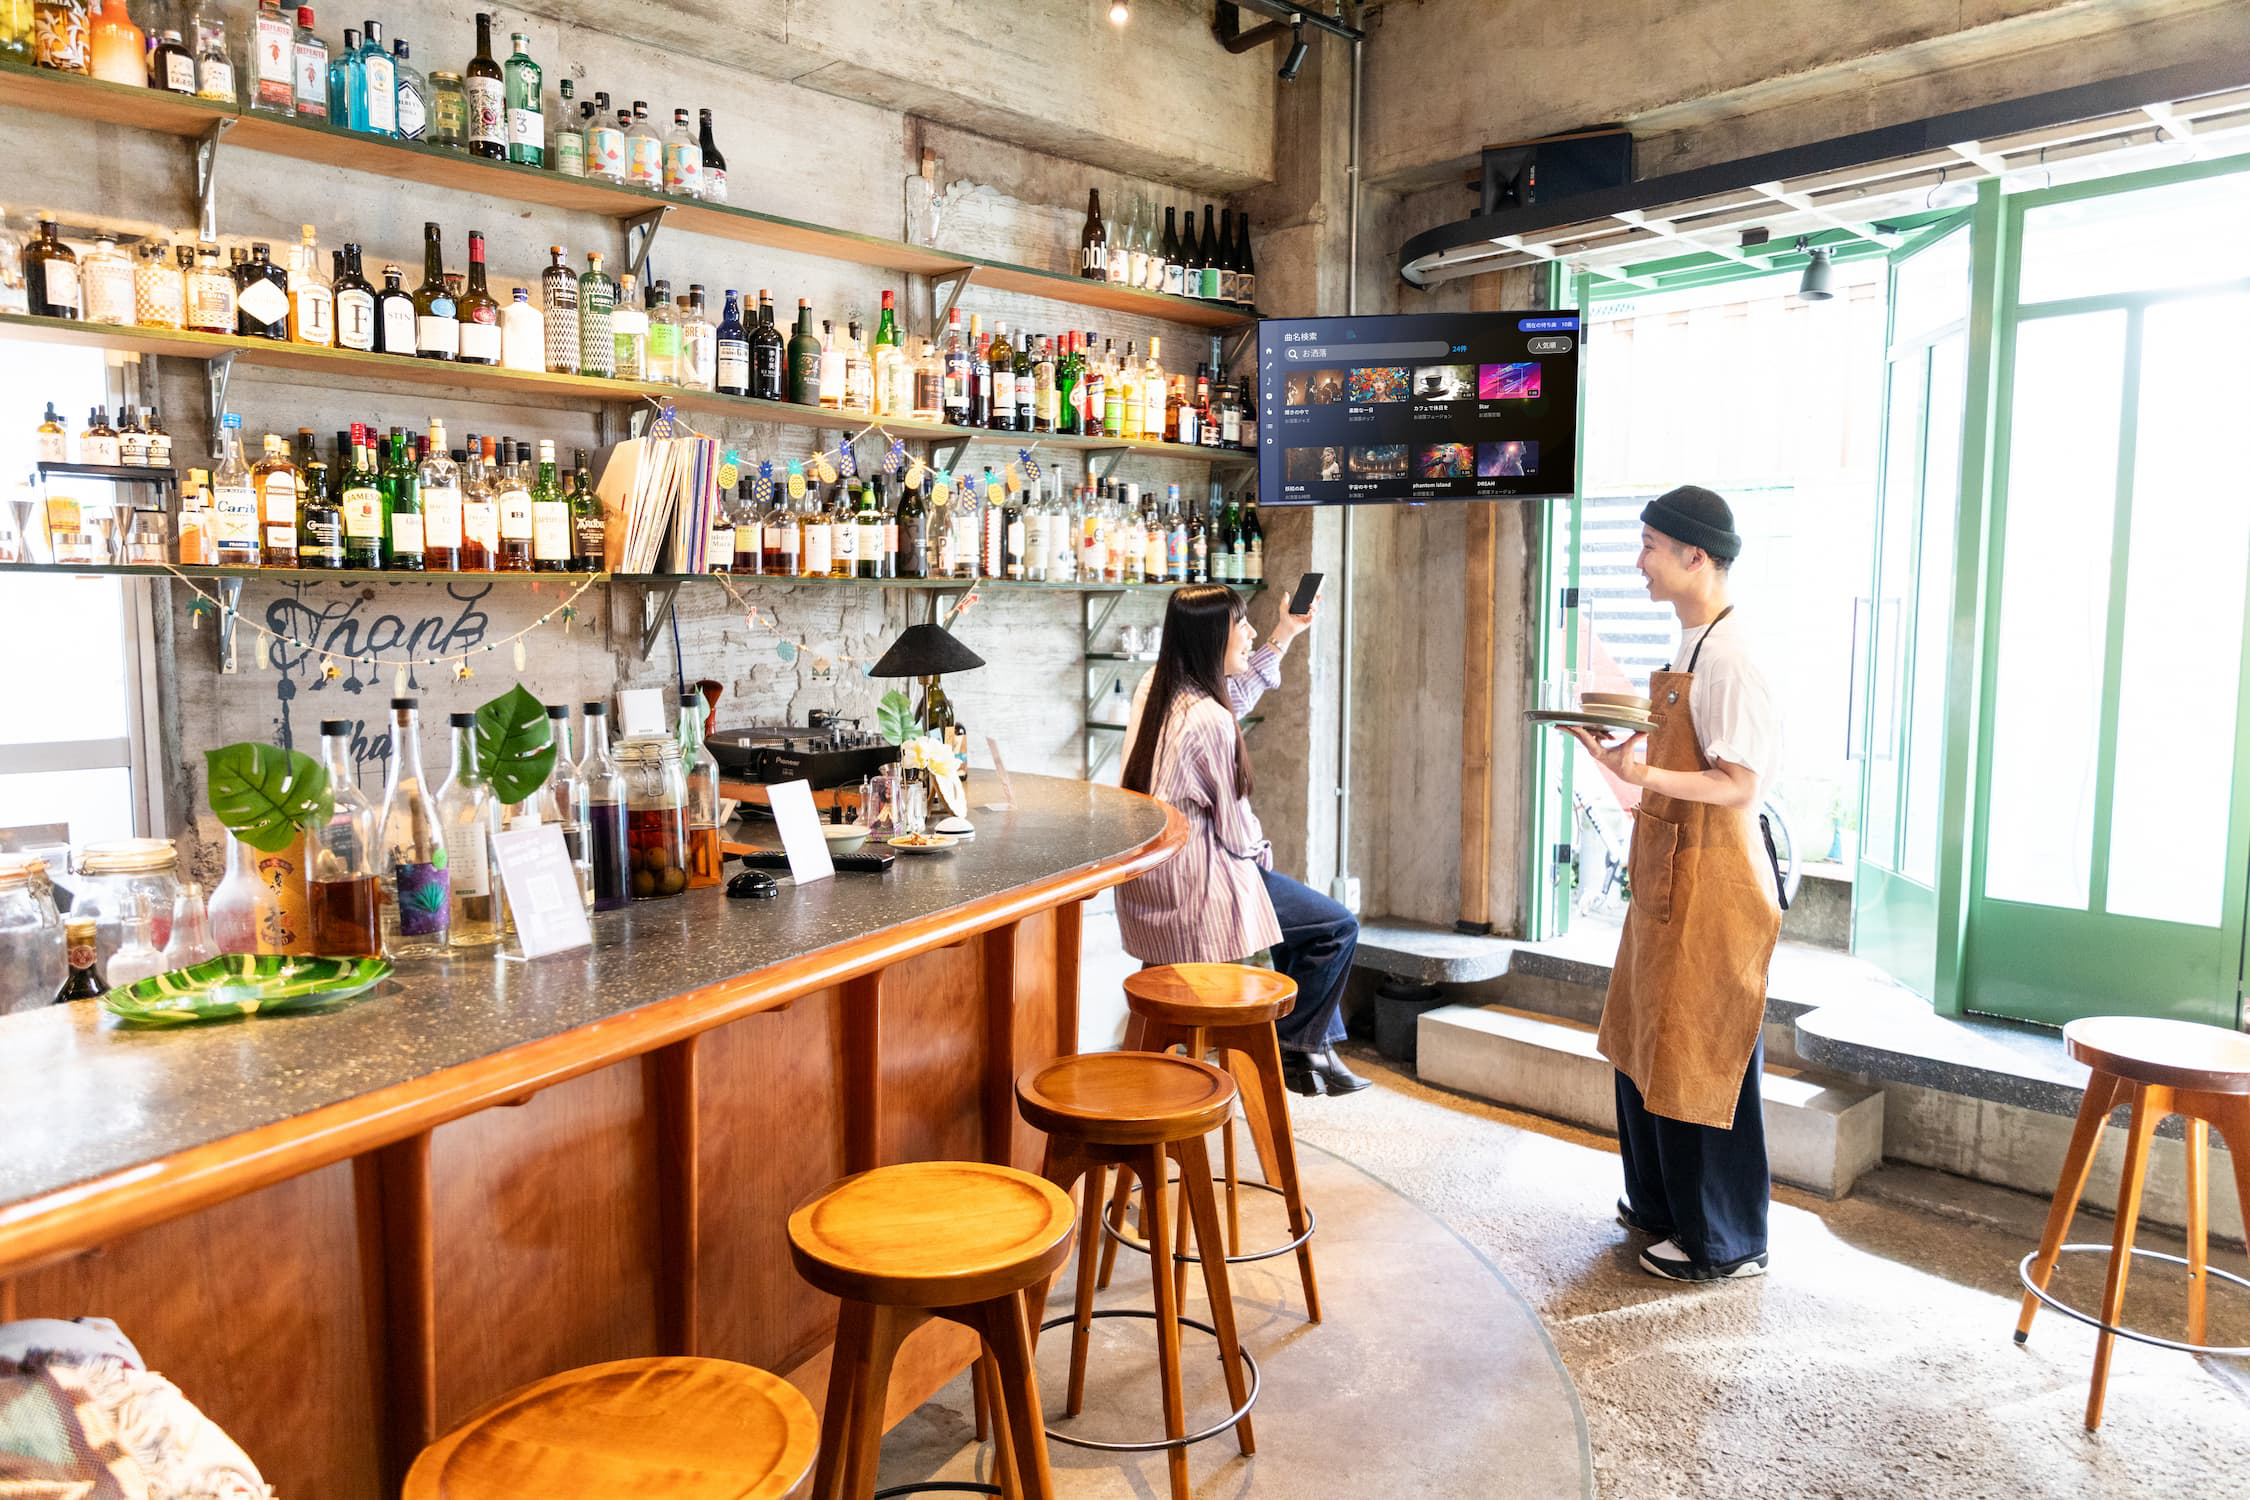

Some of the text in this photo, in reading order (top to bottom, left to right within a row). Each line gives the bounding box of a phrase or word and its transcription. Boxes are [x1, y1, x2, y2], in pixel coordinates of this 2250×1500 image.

[259, 21, 290, 35] BEEFEATER
[296, 46, 326, 59] BEEFEATER
[1284, 331, 1318, 342] 曲名検索
[1452, 345, 1467, 353] 24件
[1535, 341, 1557, 350] 人気順
[1302, 348, 1327, 358] お洒落
[217, 500, 256, 514] Carib
[266, 598, 488, 672] Thank
